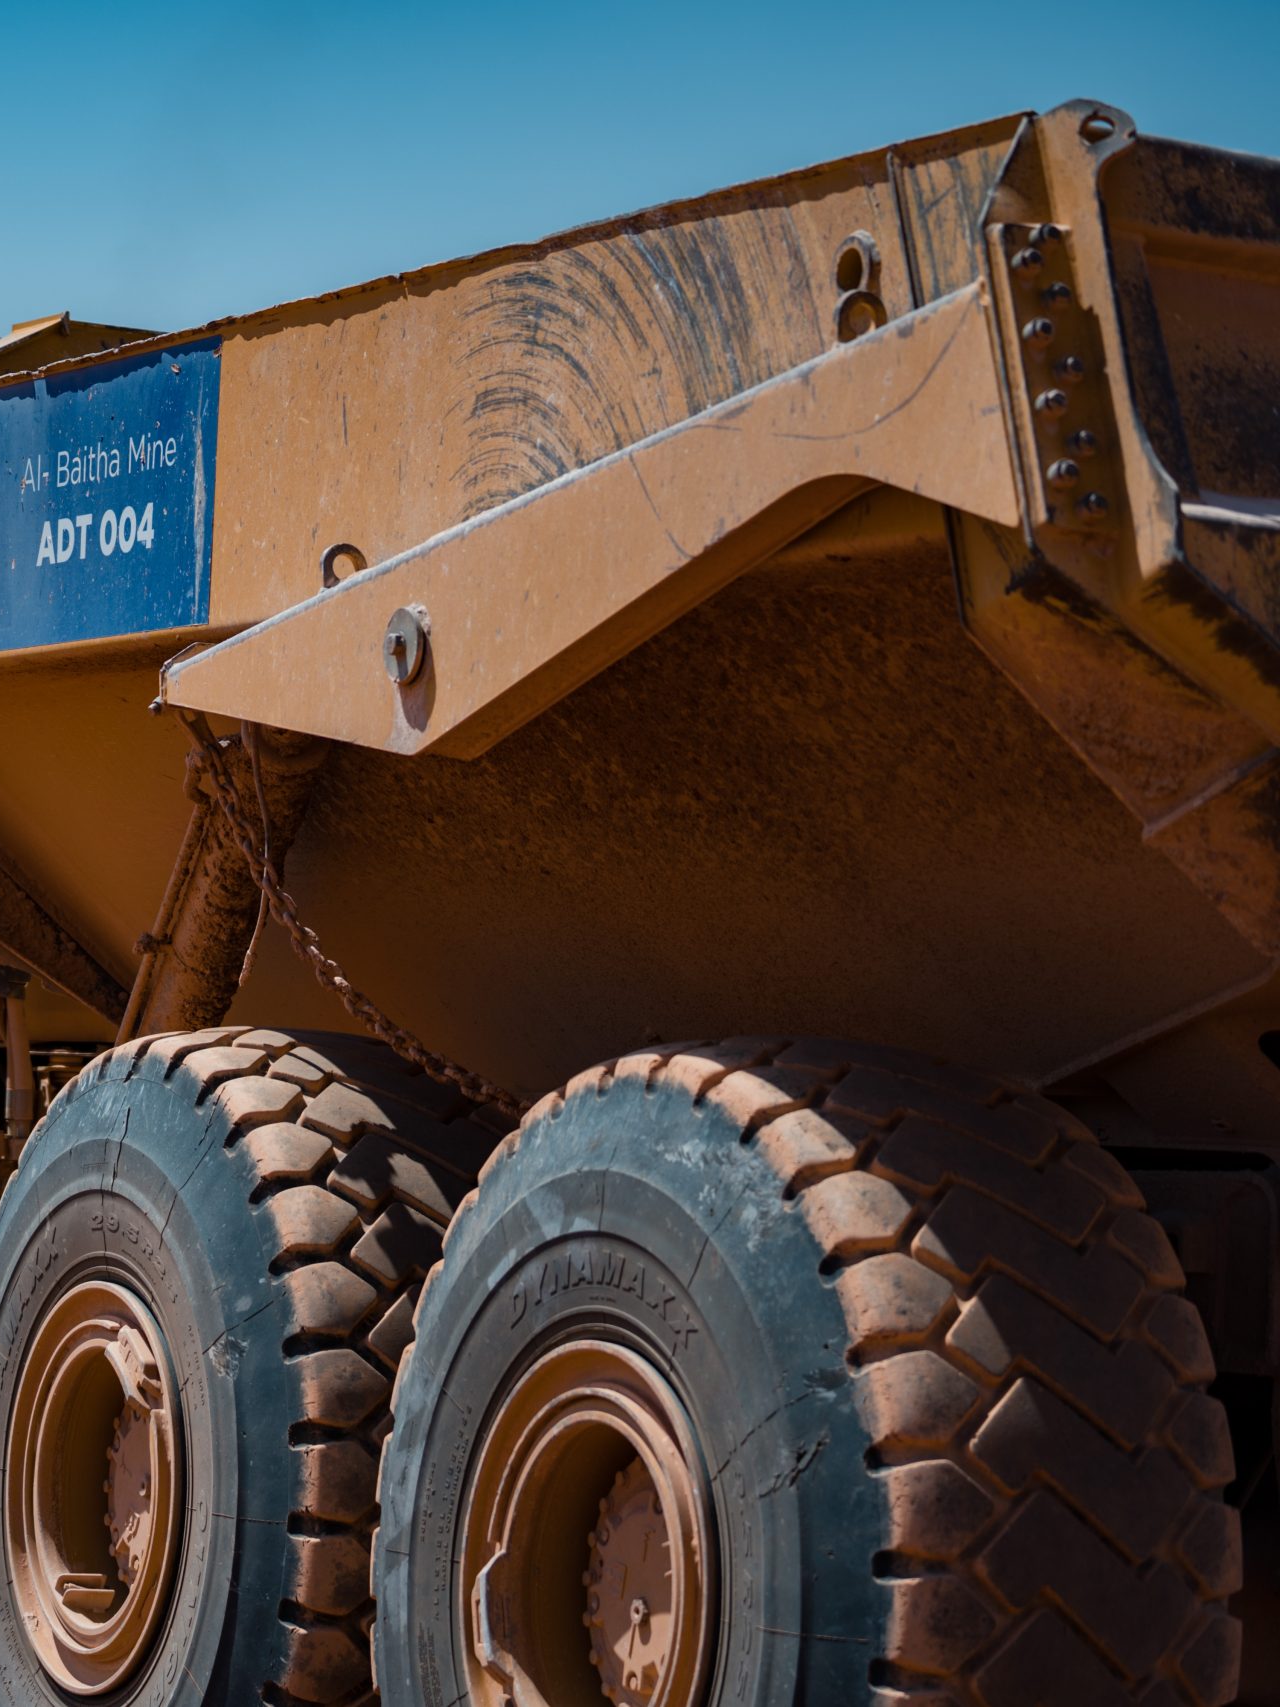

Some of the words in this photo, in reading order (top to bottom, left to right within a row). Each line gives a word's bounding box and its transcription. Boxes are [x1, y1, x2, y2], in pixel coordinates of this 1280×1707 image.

[21, 454, 49, 494] Al-
[56, 441, 120, 488] Baitha
[128, 432, 177, 474] Mine
[36, 513, 93, 567] ADT
[99, 502, 155, 557] 004
[510, 1250, 699, 1349] DYNAMAXX
